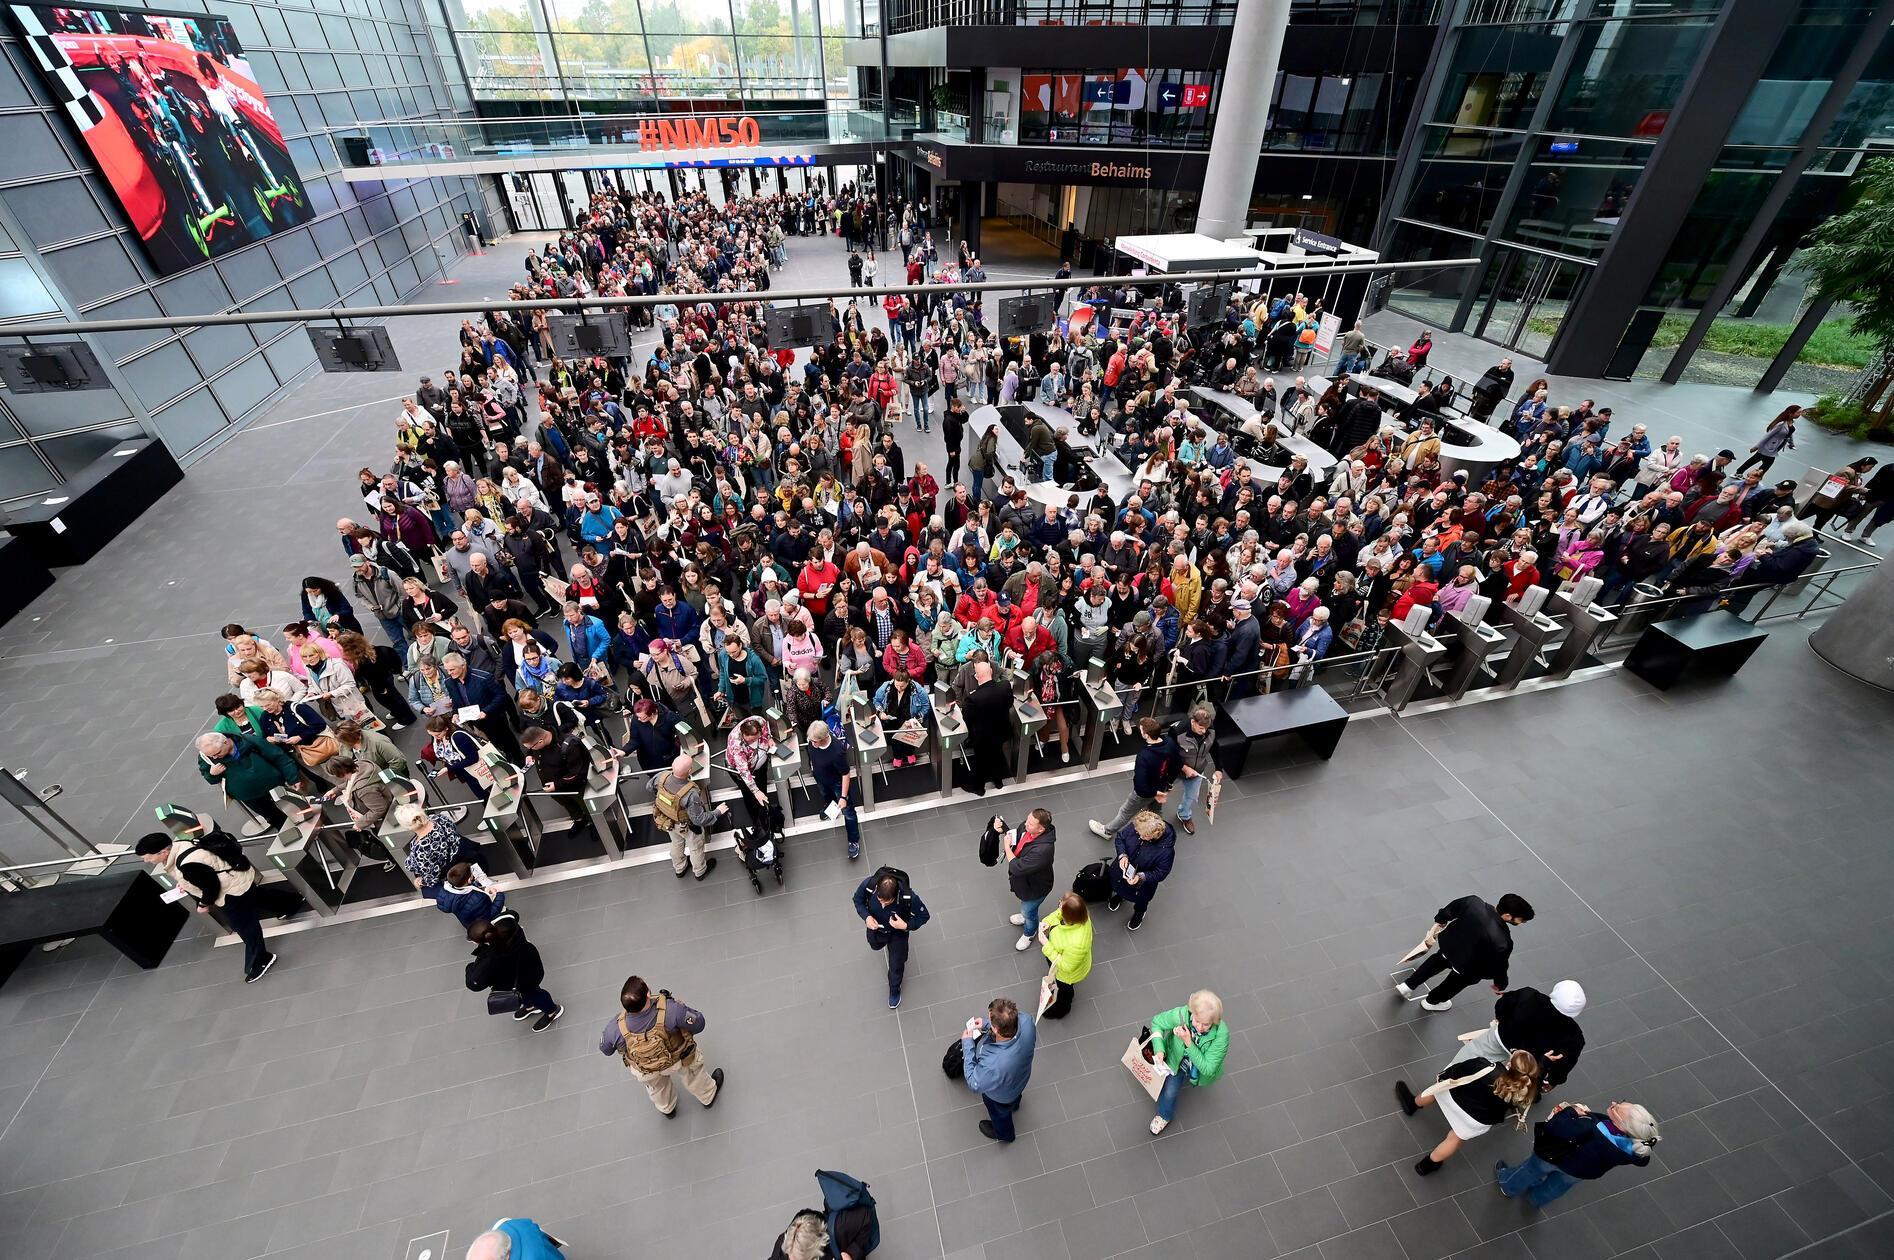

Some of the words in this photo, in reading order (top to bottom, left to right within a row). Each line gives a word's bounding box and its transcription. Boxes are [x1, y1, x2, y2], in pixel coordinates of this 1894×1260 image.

[638, 117, 760, 151] #NM50
[1024, 160, 1091, 174] Restaurant
[1091, 162, 1152, 179] Behaims
[1302, 236, 1317, 246] Service
[1317, 240, 1338, 252] Entrance
